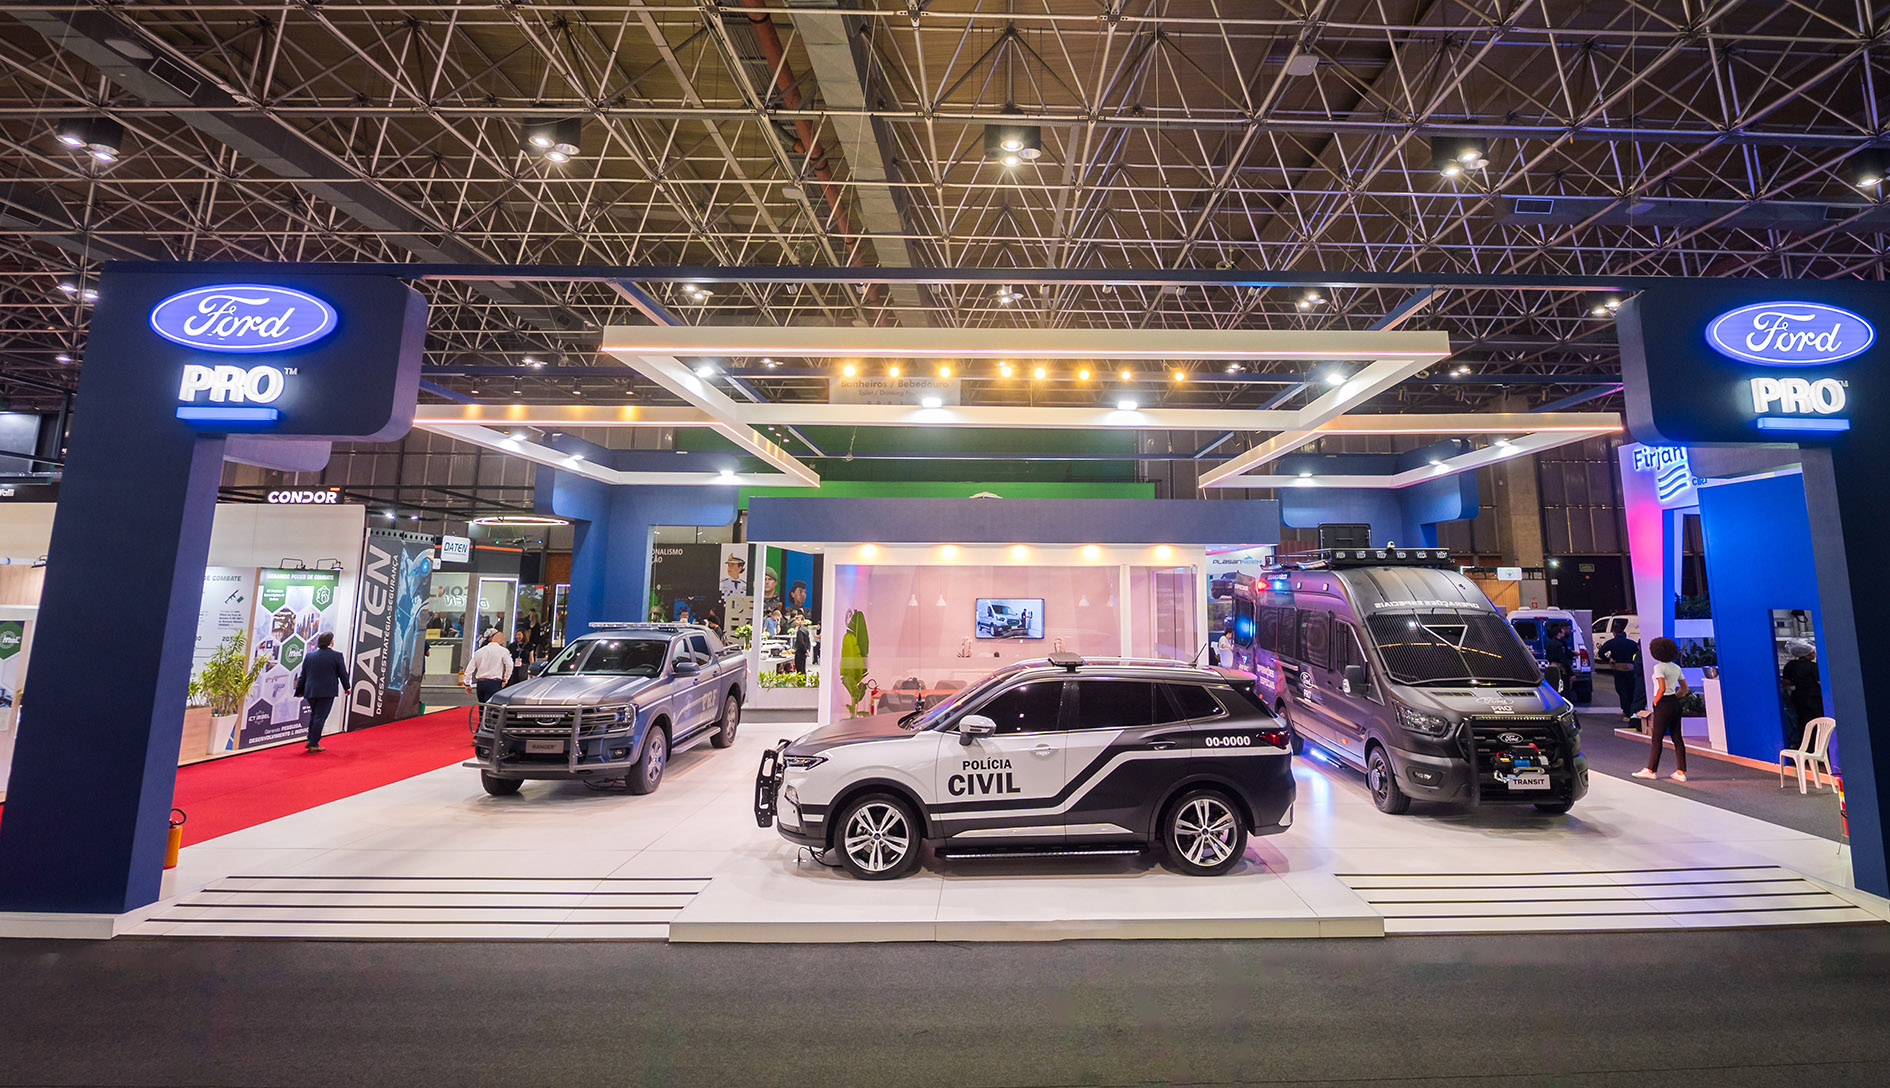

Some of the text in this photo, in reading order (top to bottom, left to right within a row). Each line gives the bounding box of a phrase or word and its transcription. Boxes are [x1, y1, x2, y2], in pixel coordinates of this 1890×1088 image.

[184, 295, 295, 338] Ford
[1746, 312, 1841, 352] Ford
[841, 379, 888, 388] Banheiros
[1633, 447, 1684, 471] Firjan
[268, 491, 338, 504] CONDOR
[443, 541, 468, 553] DATEN
[352, 544, 392, 718] DATEN
[1205, 736, 1251, 747] 00-0000
[962, 757, 1012, 770] POLÍCIA
[948, 772, 1021, 796] CIVIL
